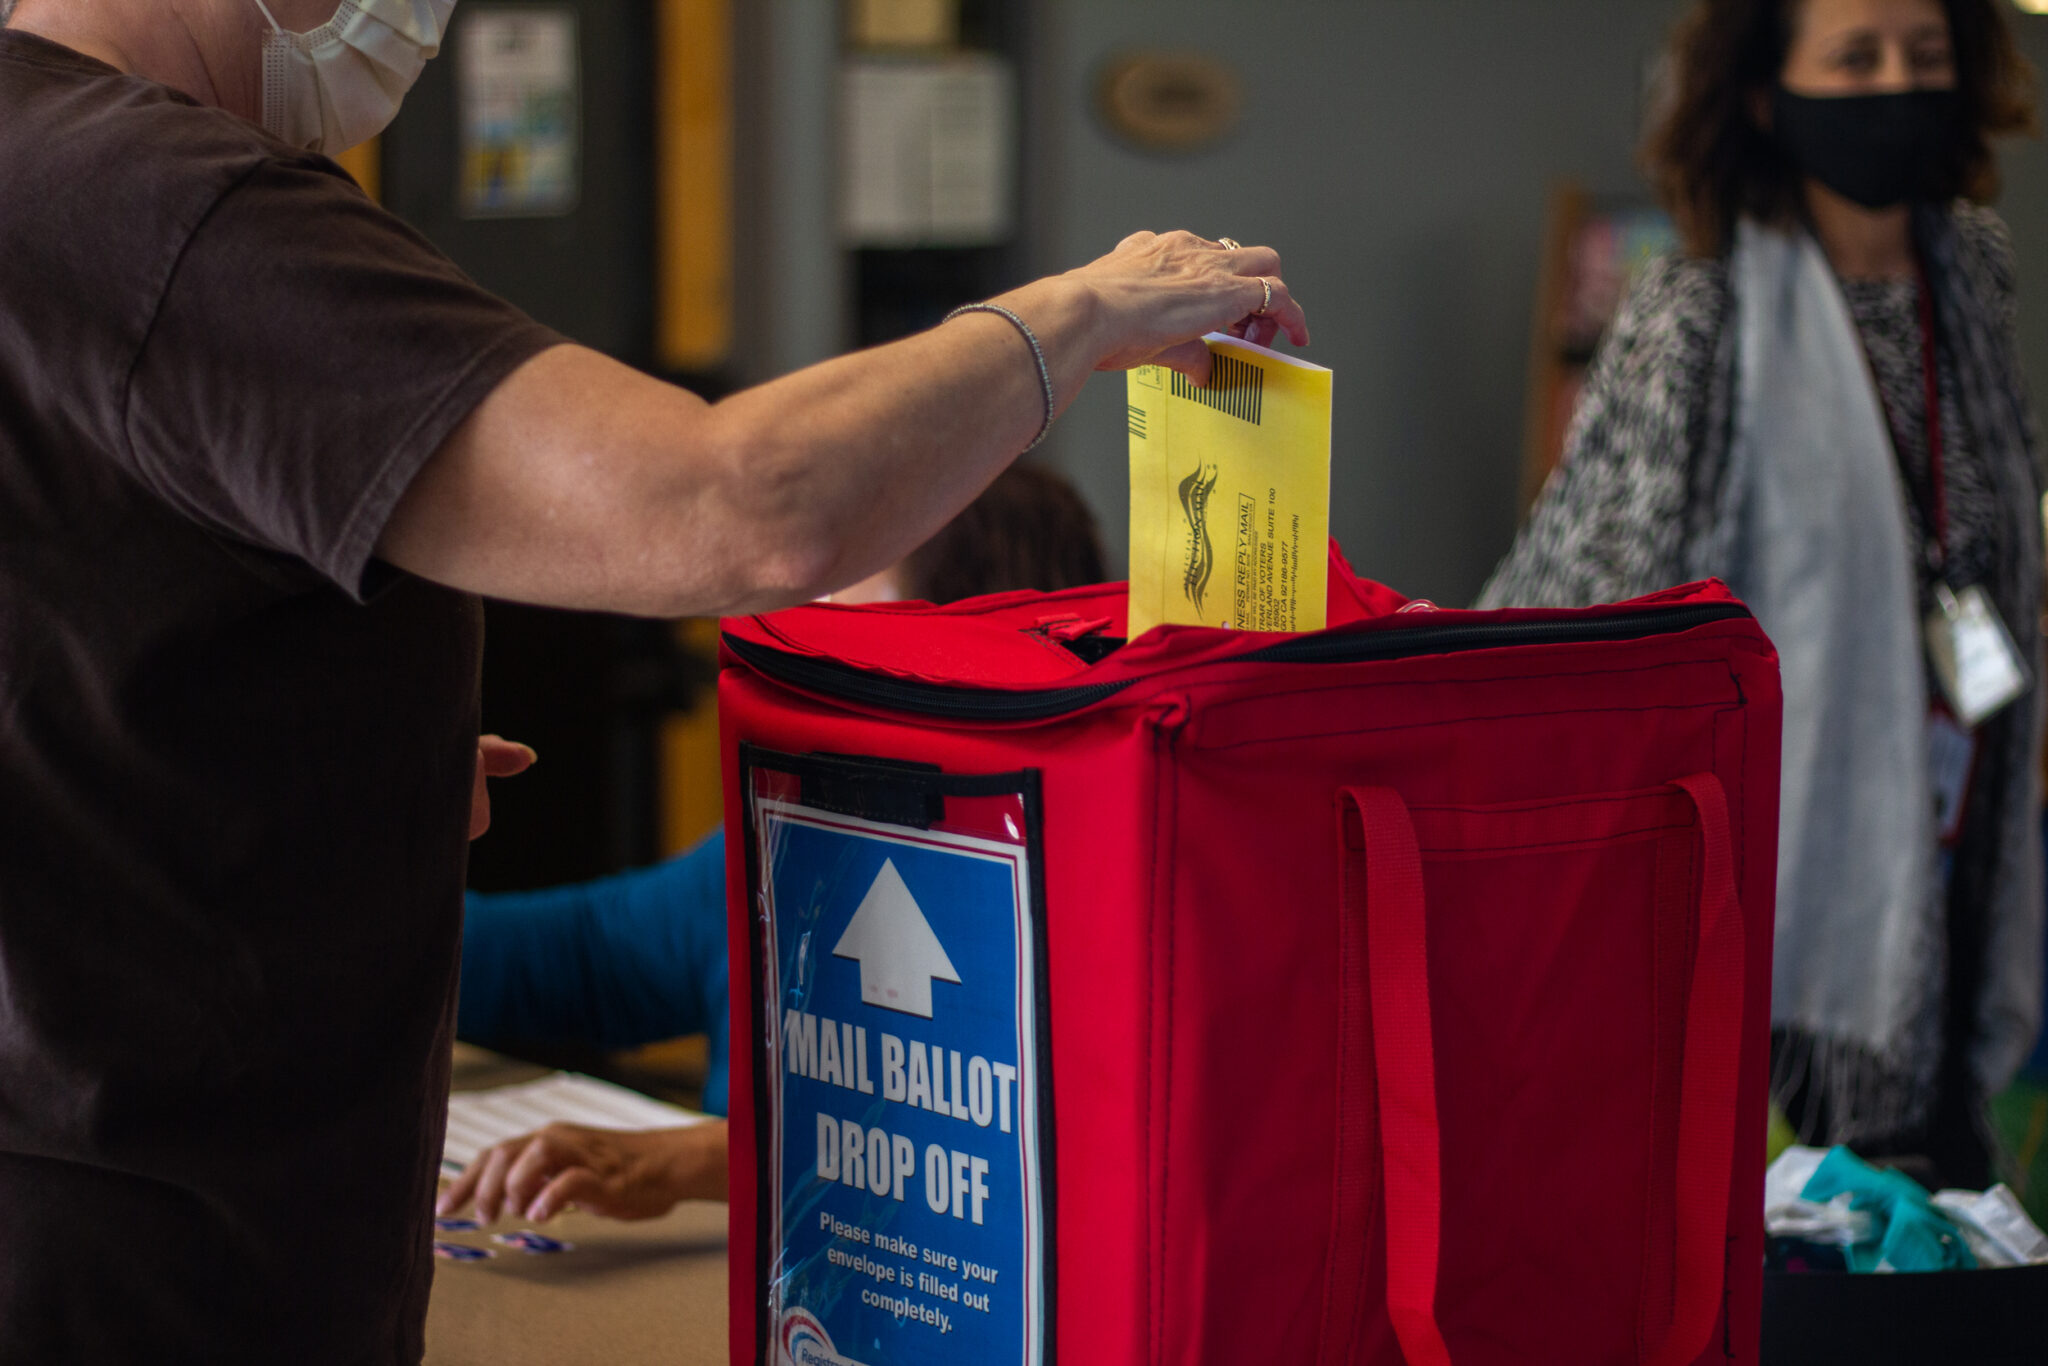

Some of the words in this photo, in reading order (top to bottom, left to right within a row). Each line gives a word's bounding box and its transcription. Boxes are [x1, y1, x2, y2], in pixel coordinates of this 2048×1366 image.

[1240, 502, 1249, 536] MAIL
[1237, 538, 1247, 586] REPLY
[1237, 589, 1246, 629] NESS
[1260, 587, 1266, 602] OF
[1281, 599, 1287, 613] CA
[786, 1008, 874, 1095] MAIL
[881, 1032, 1016, 1134] BALLOT
[816, 1111, 915, 1202] DROP
[924, 1143, 990, 1226] OFF
[820, 1211, 870, 1245] Please
[874, 1229, 918, 1260] make
[922, 1248, 958, 1272] sure
[962, 1258, 999, 1285] your
[827, 1247, 896, 1284] envelope
[900, 1265, 914, 1289] is
[918, 1272, 959, 1303] filled
[963, 1289, 991, 1314] out
[861, 1287, 953, 1334] completely.
